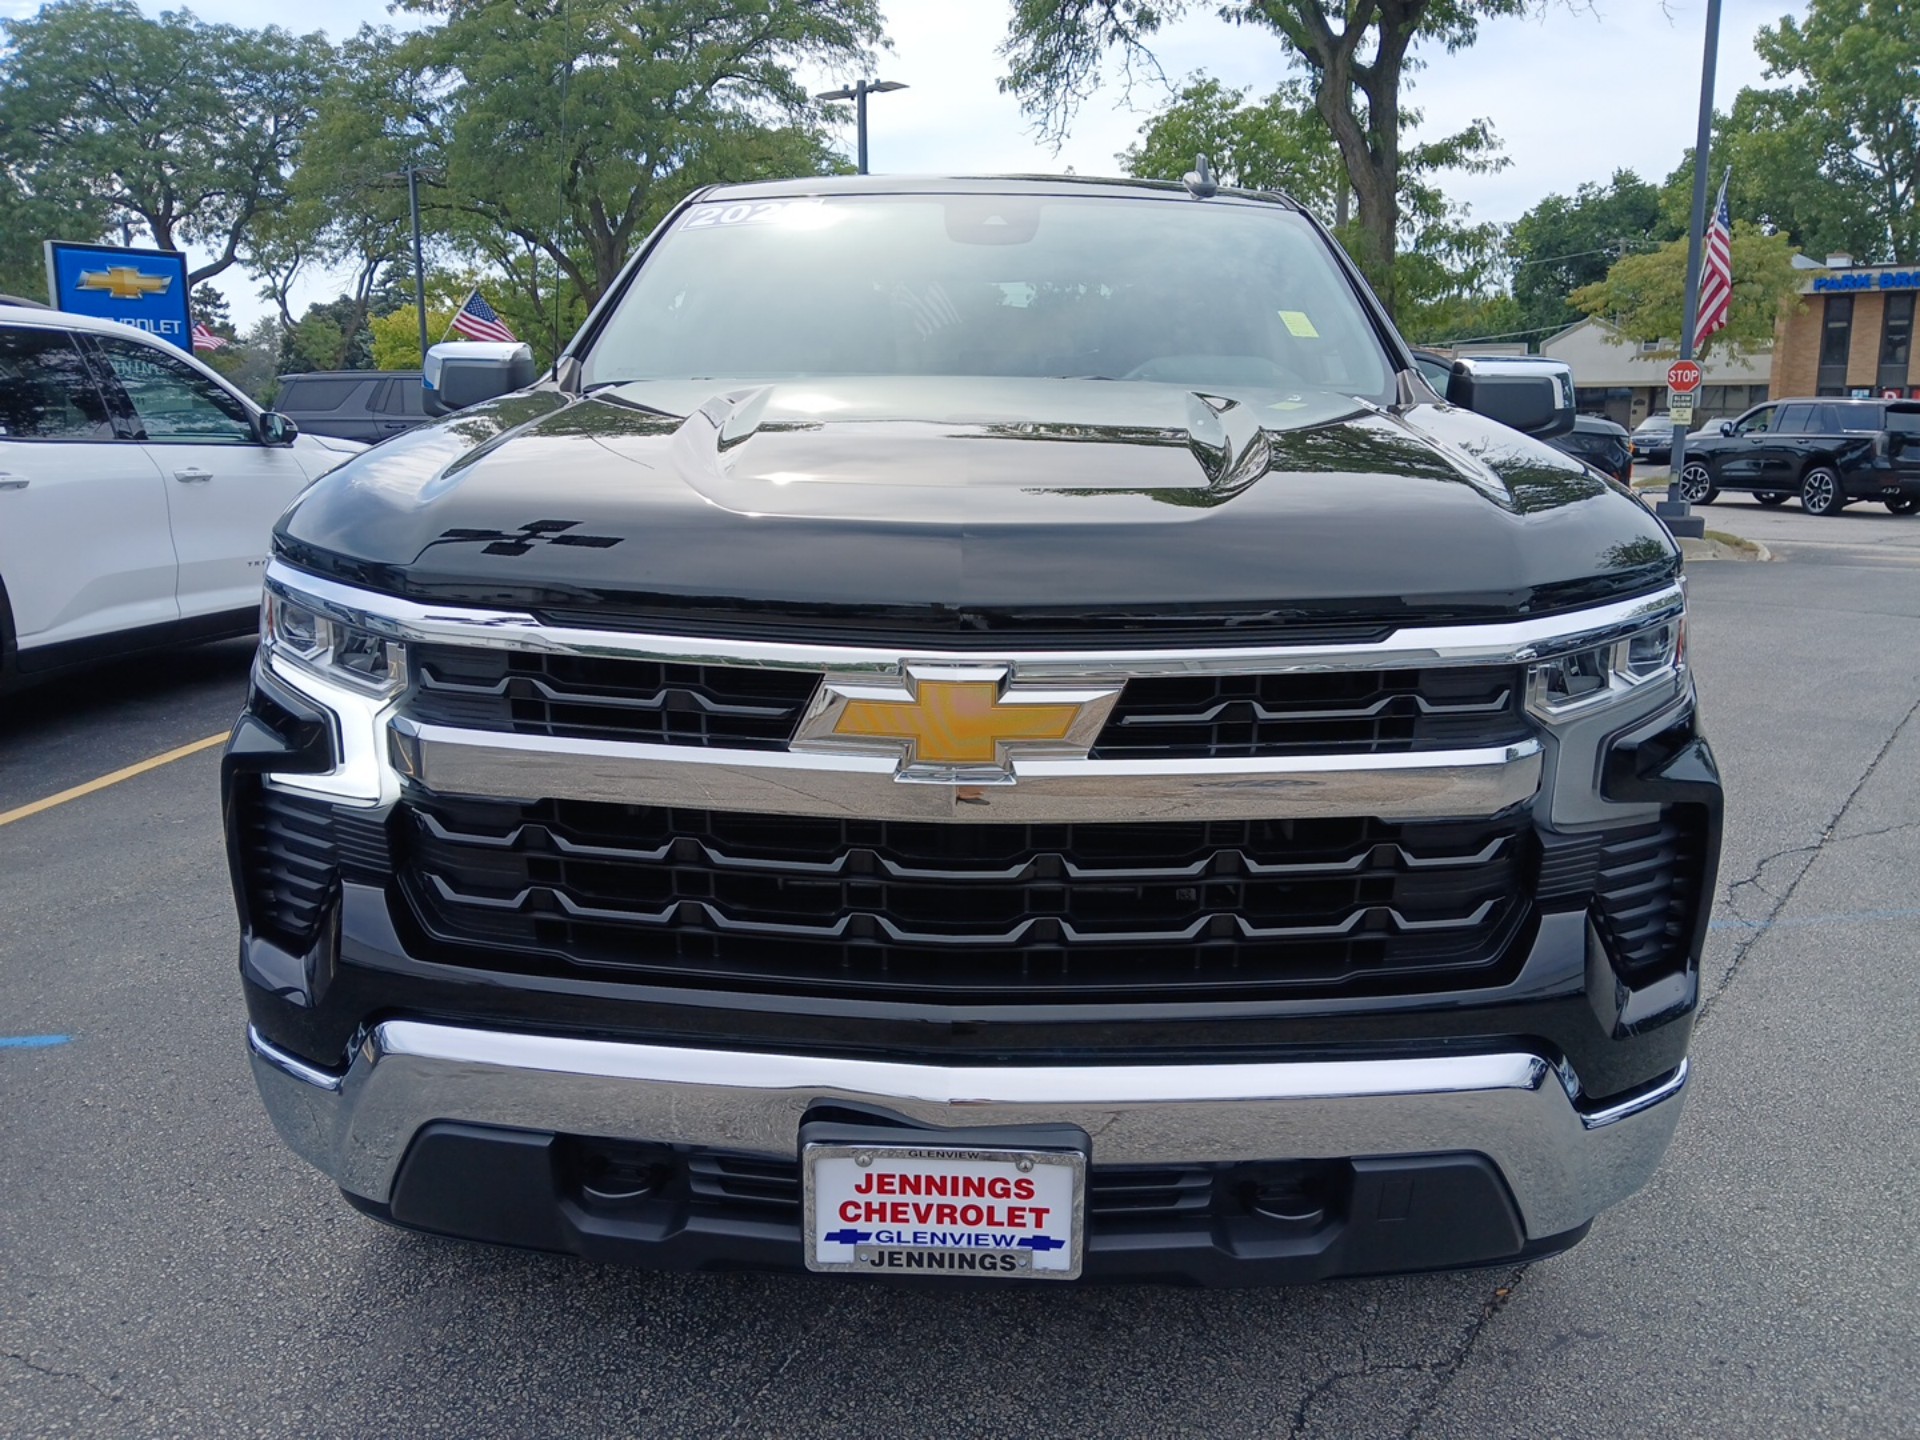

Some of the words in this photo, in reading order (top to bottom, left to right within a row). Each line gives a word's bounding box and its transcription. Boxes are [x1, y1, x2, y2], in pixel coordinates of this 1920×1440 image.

[688, 202, 798, 227] 202
[1813, 273, 1872, 291] PARK
[1668, 369, 1699, 383] STOP
[908, 1150, 980, 1160] GLENVIEW
[854, 1173, 1036, 1201] JENNINGS
[838, 1200, 1051, 1229] CHEVROLET
[875, 1230, 1016, 1247] GLENVIEW
[870, 1251, 1017, 1272] JENNINGS
